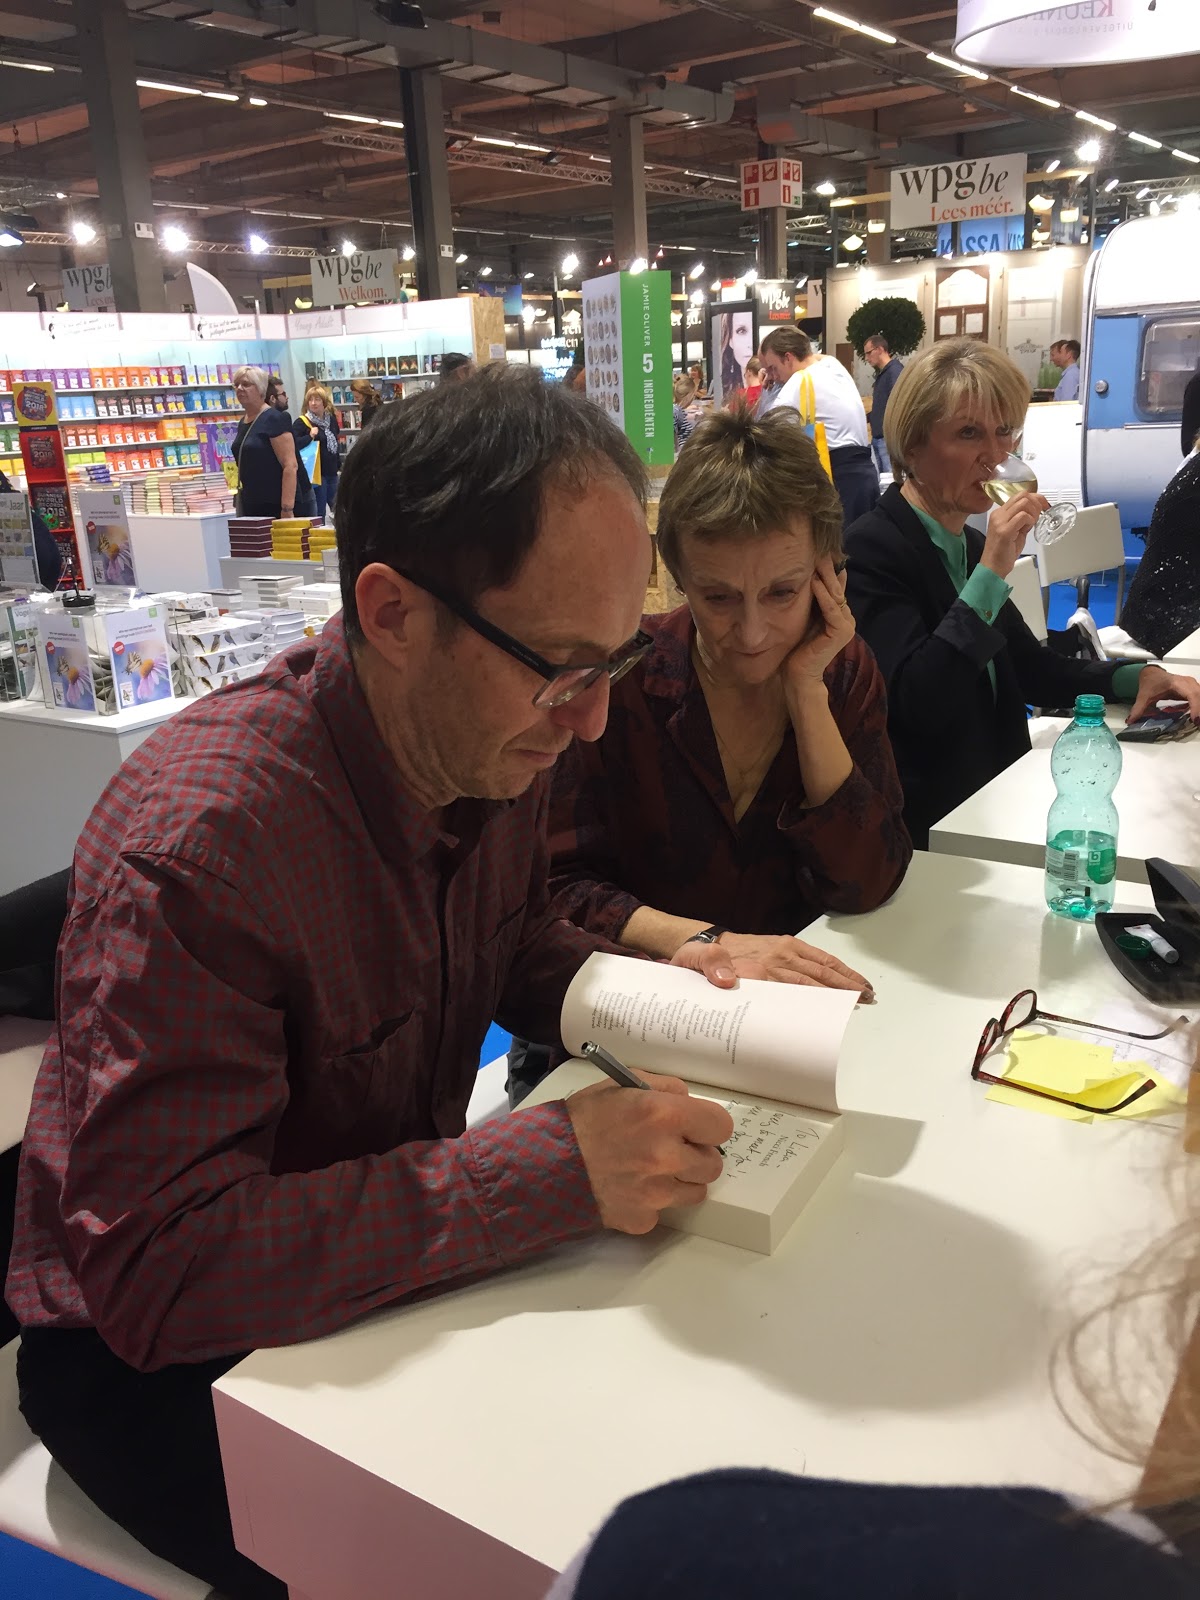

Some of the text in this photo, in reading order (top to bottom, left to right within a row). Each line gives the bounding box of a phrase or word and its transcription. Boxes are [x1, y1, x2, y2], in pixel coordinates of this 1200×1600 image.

[930, 206, 967, 222] Lees
[941, 233, 1000, 254] KSSA
[338, 286, 388, 302] Welkom.
[641, 283, 650, 311] JAMIE
[643, 313, 651, 347] OLIVER
[642, 353, 654, 374] 5
[39, 507, 66, 517] 2018
[796, 1127, 820, 1140] To
[759, 1134, 789, 1167] Nicci French
